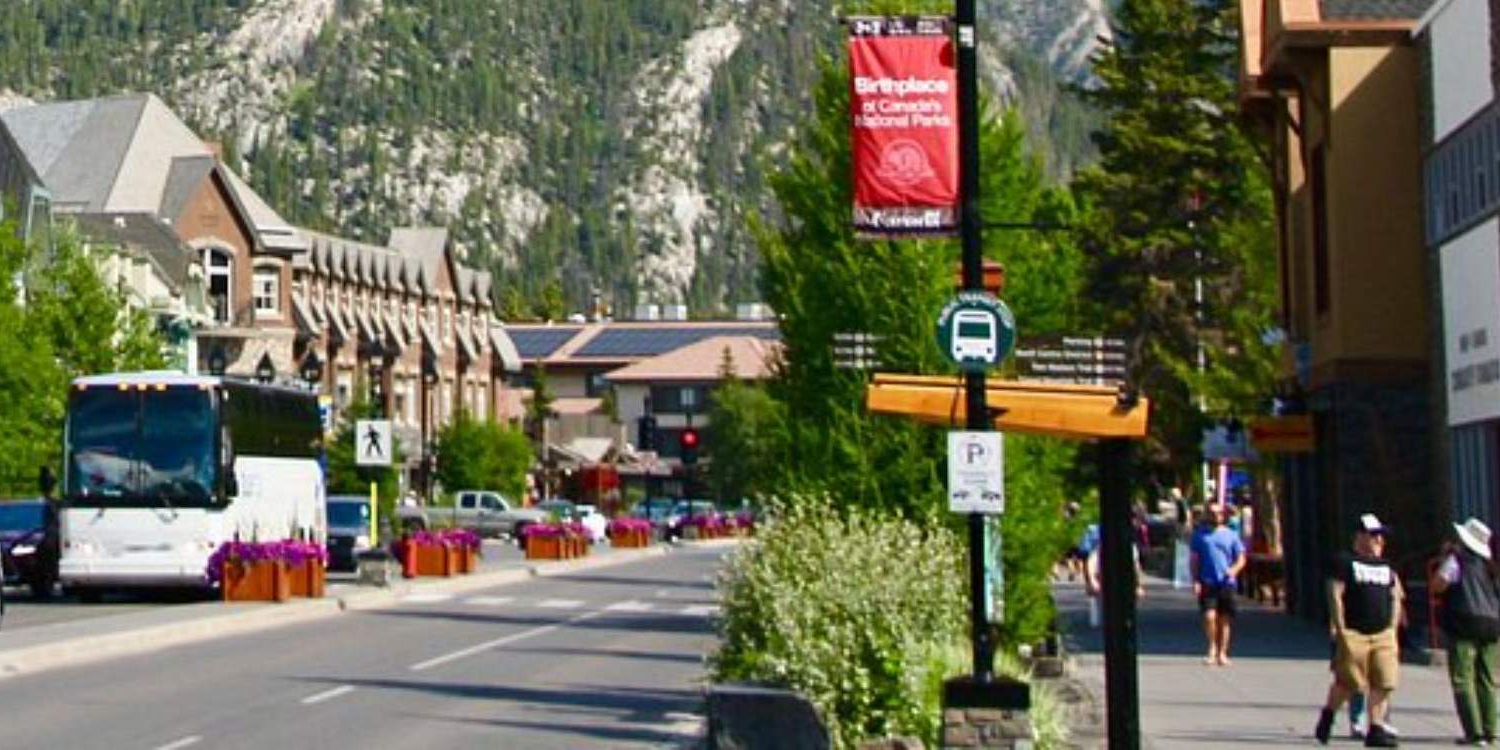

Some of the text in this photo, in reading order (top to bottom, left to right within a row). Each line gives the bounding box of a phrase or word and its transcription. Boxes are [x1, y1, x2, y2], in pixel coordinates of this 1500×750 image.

[854, 76, 949, 97] Birthplace
[862, 100, 943, 114] of Canada's
[854, 114, 950, 128] National Parks
[967, 443, 984, 464] P
